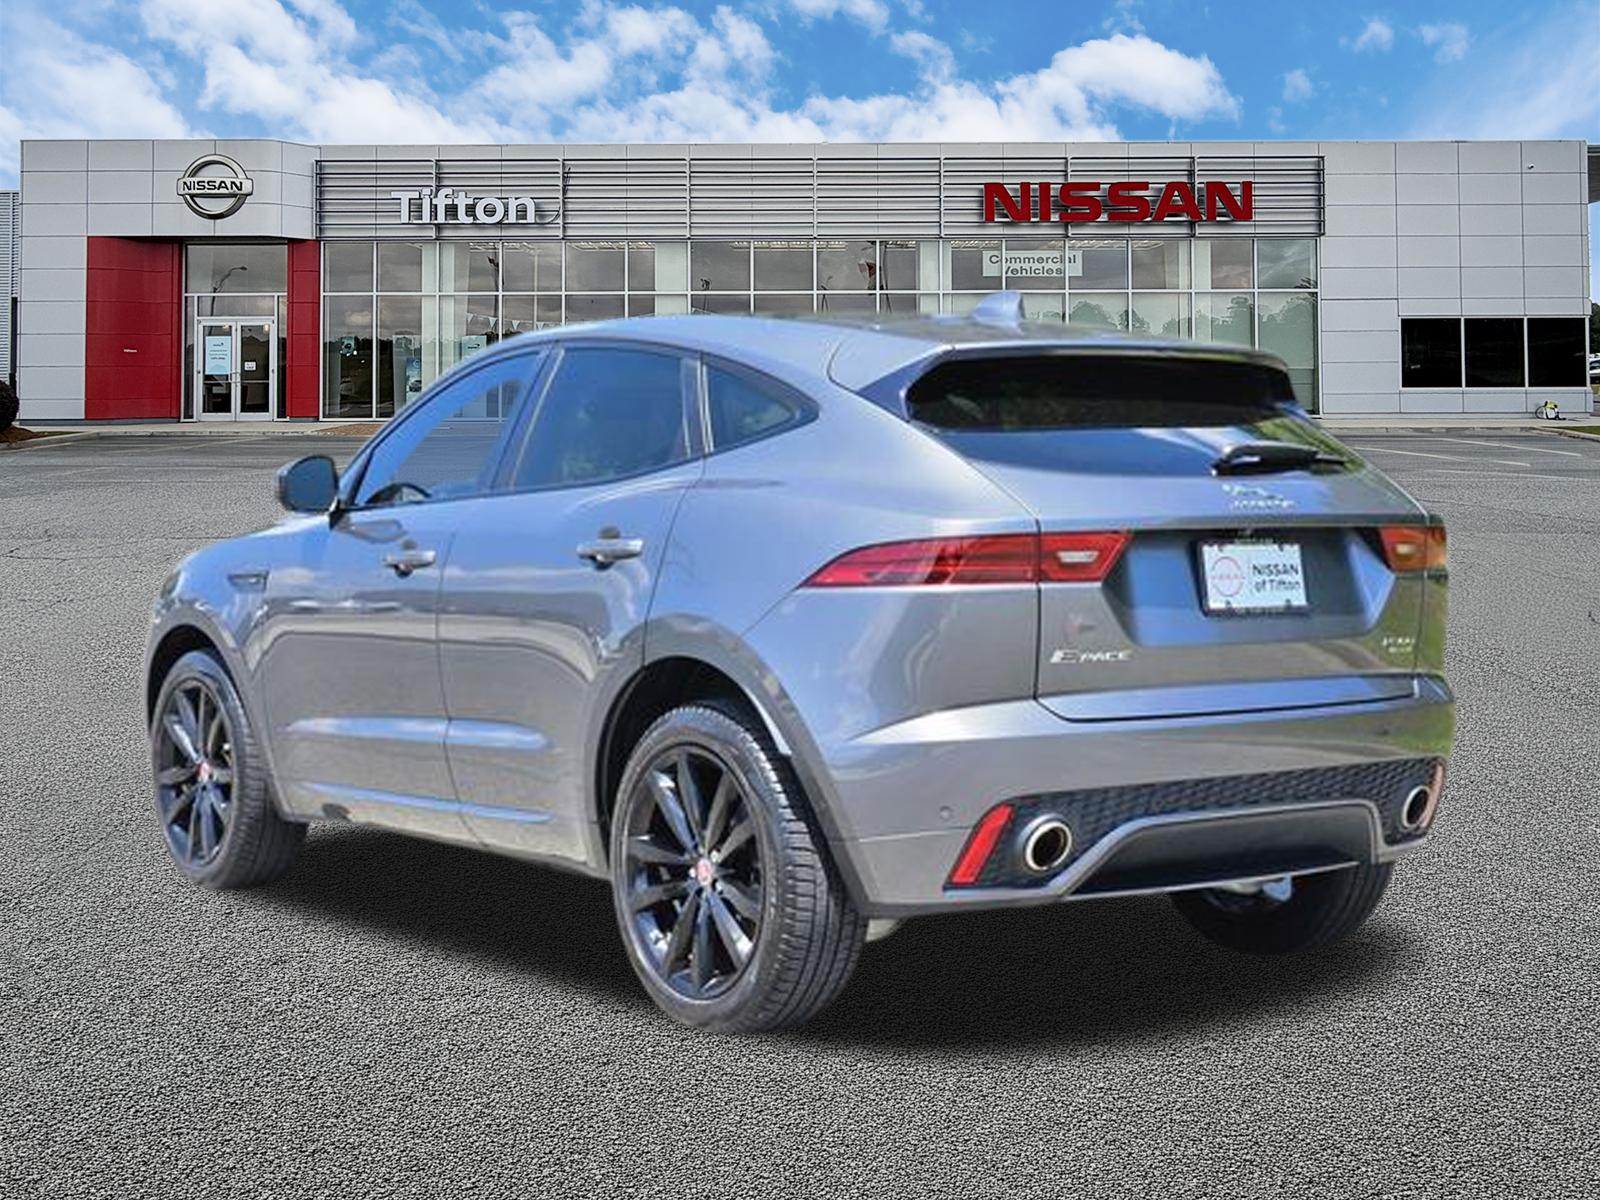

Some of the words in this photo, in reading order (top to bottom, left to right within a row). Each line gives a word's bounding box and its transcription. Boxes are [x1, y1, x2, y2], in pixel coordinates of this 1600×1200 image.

[182, 180, 243, 191] NISSAN
[391, 188, 536, 224] Tifton
[983, 180, 1253, 222] NISSAN
[1252, 563, 1299, 577] NISSAN
